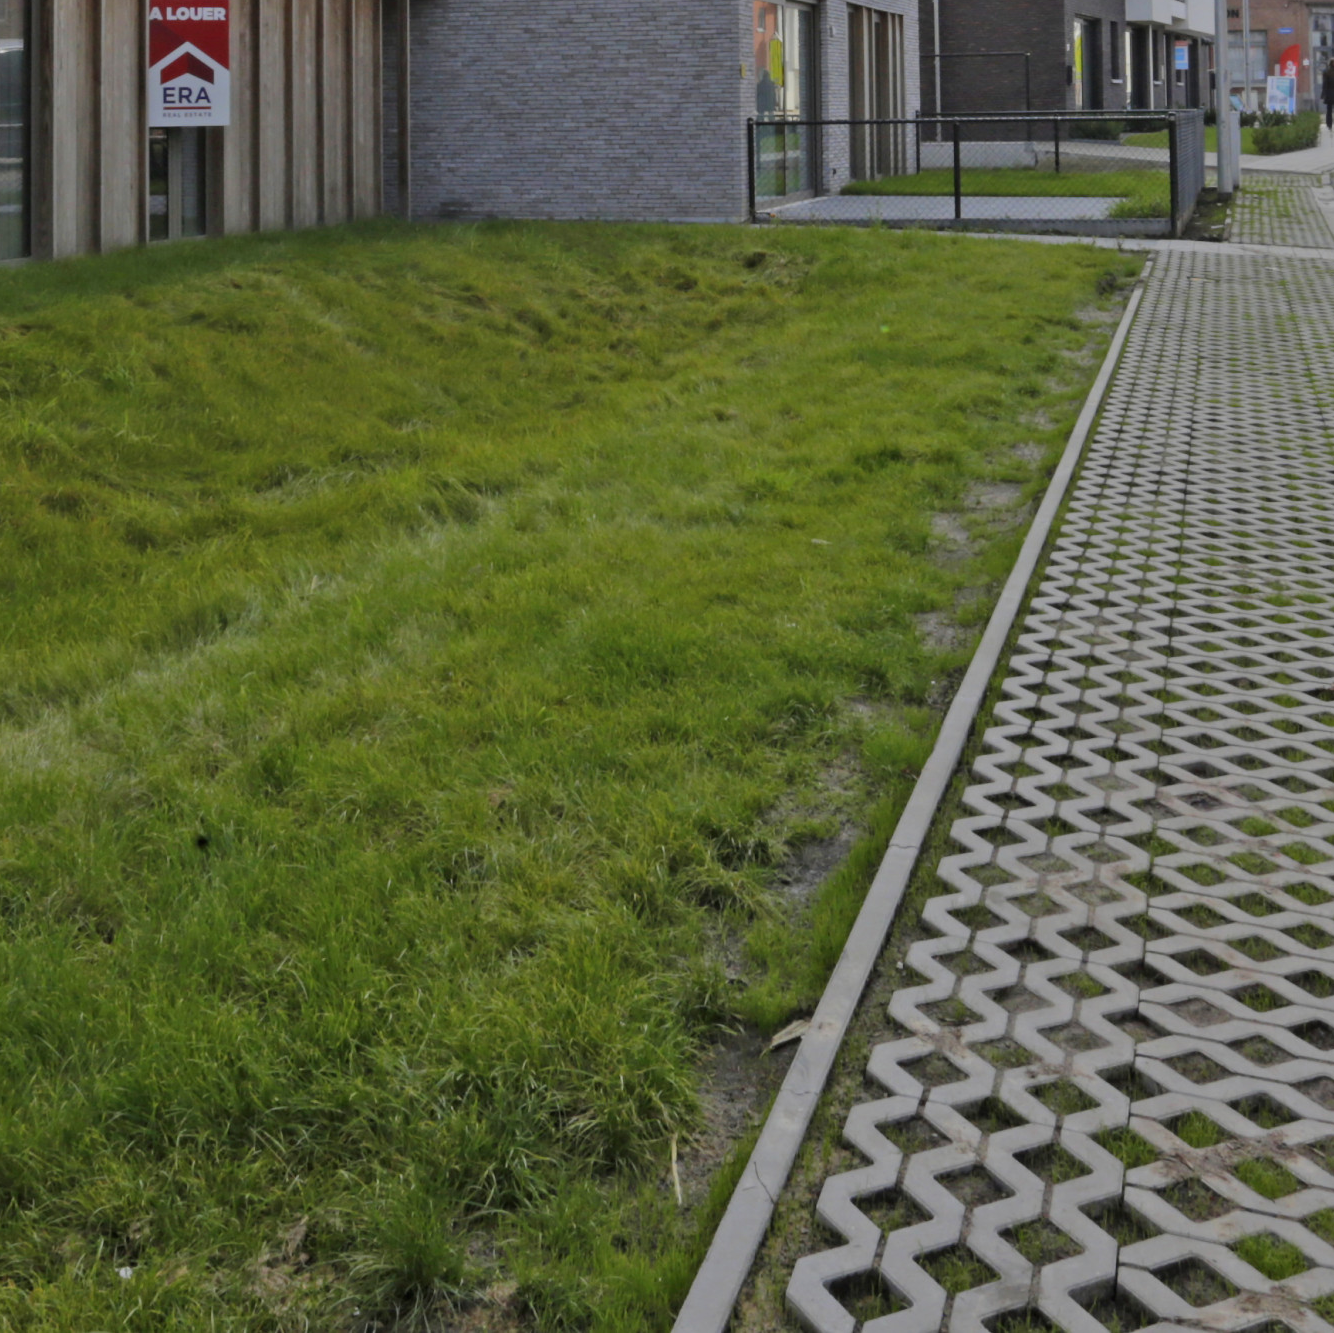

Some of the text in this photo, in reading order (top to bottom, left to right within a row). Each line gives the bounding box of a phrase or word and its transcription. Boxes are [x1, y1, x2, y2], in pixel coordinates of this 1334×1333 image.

[149, 6, 226, 21] A LOUER
[163, 86, 212, 104] ERA
